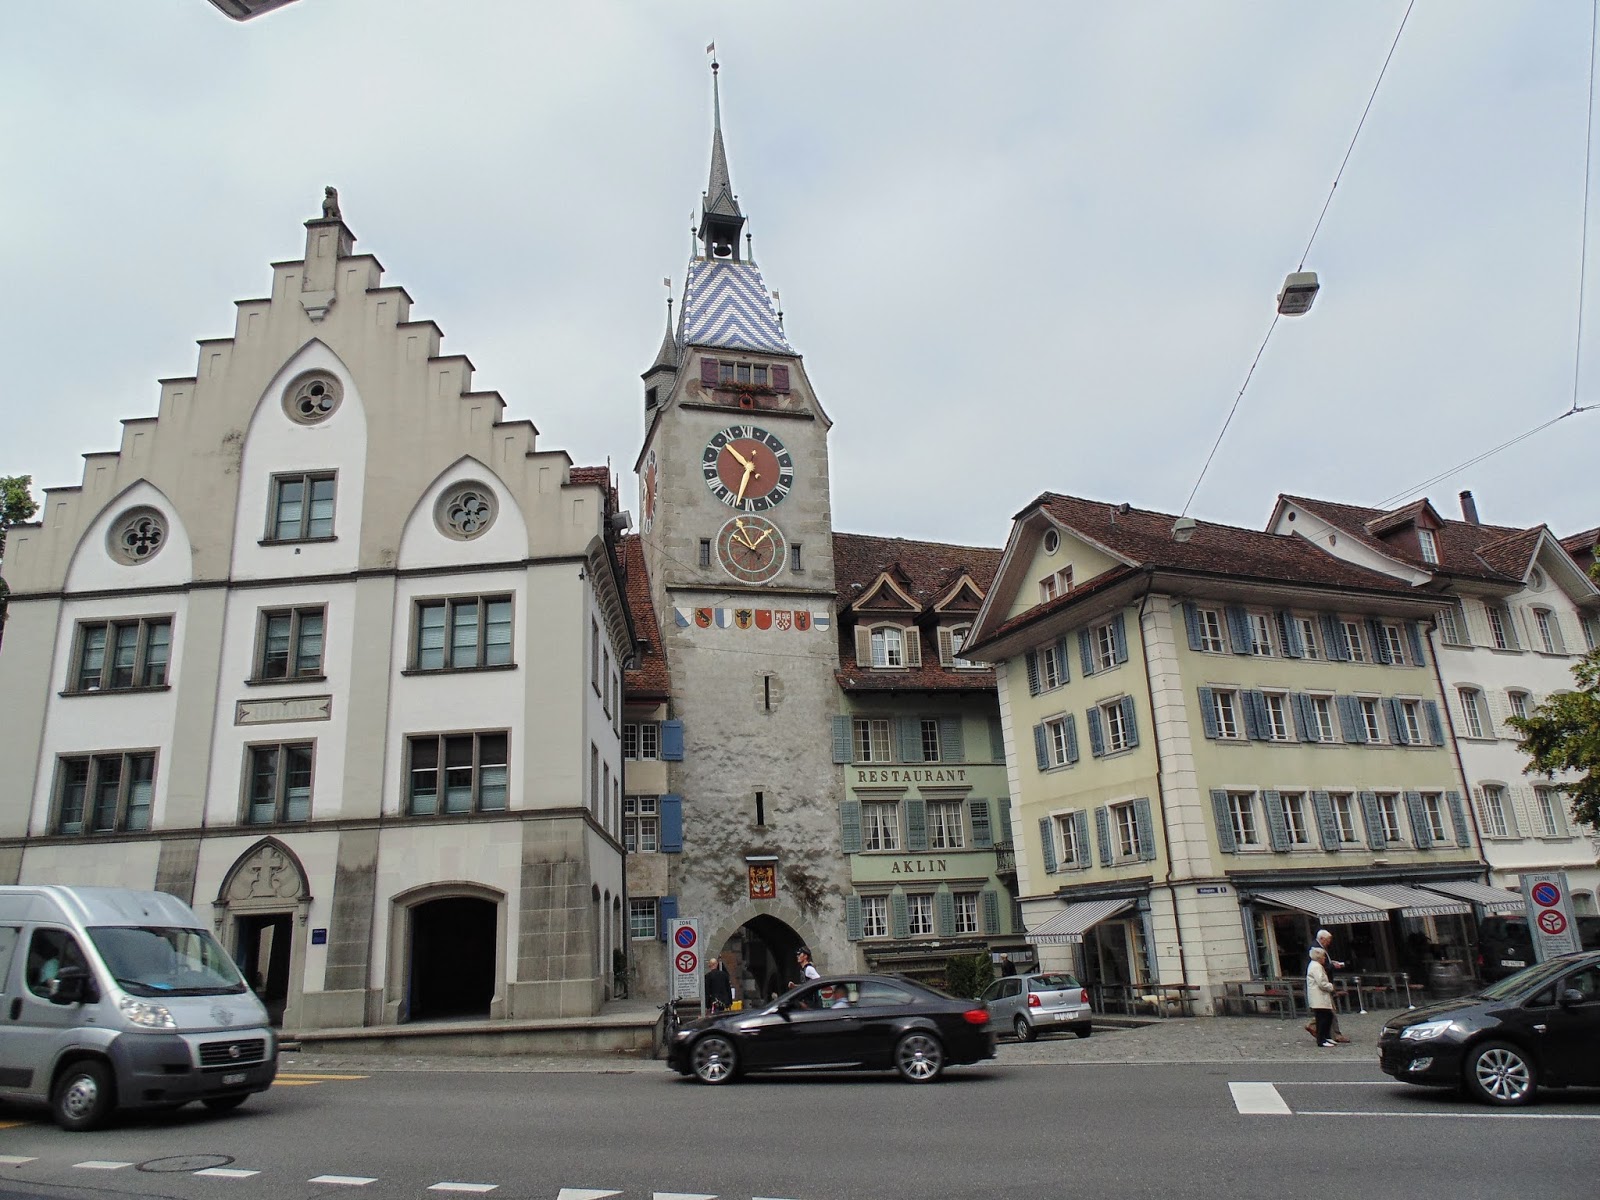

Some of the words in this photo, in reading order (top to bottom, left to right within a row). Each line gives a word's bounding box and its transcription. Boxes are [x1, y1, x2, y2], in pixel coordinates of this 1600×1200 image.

[720, 428, 735, 442] XI
[740, 426, 754, 439] XII
[763, 433, 771, 443] I
[707, 442, 721, 452] X
[775, 448, 787, 457] II
[703, 460, 717, 469] IX
[780, 466, 793, 476] III
[706, 477, 723, 494] VIII
[776, 483, 790, 497] IV
[721, 491, 737, 508] VII
[745, 499, 755, 511] VI
[765, 496, 775, 509] V
[858, 770, 966, 783] RESTAURANT
[892, 860, 947, 874] AKLIN
[1407, 905, 1468, 917] FELSENKELLER
[1489, 902, 1525, 912] FELSENKE
[1322, 912, 1388, 924] FELSENKELLER
[1029, 935, 1078, 944] FELSENKELLER
